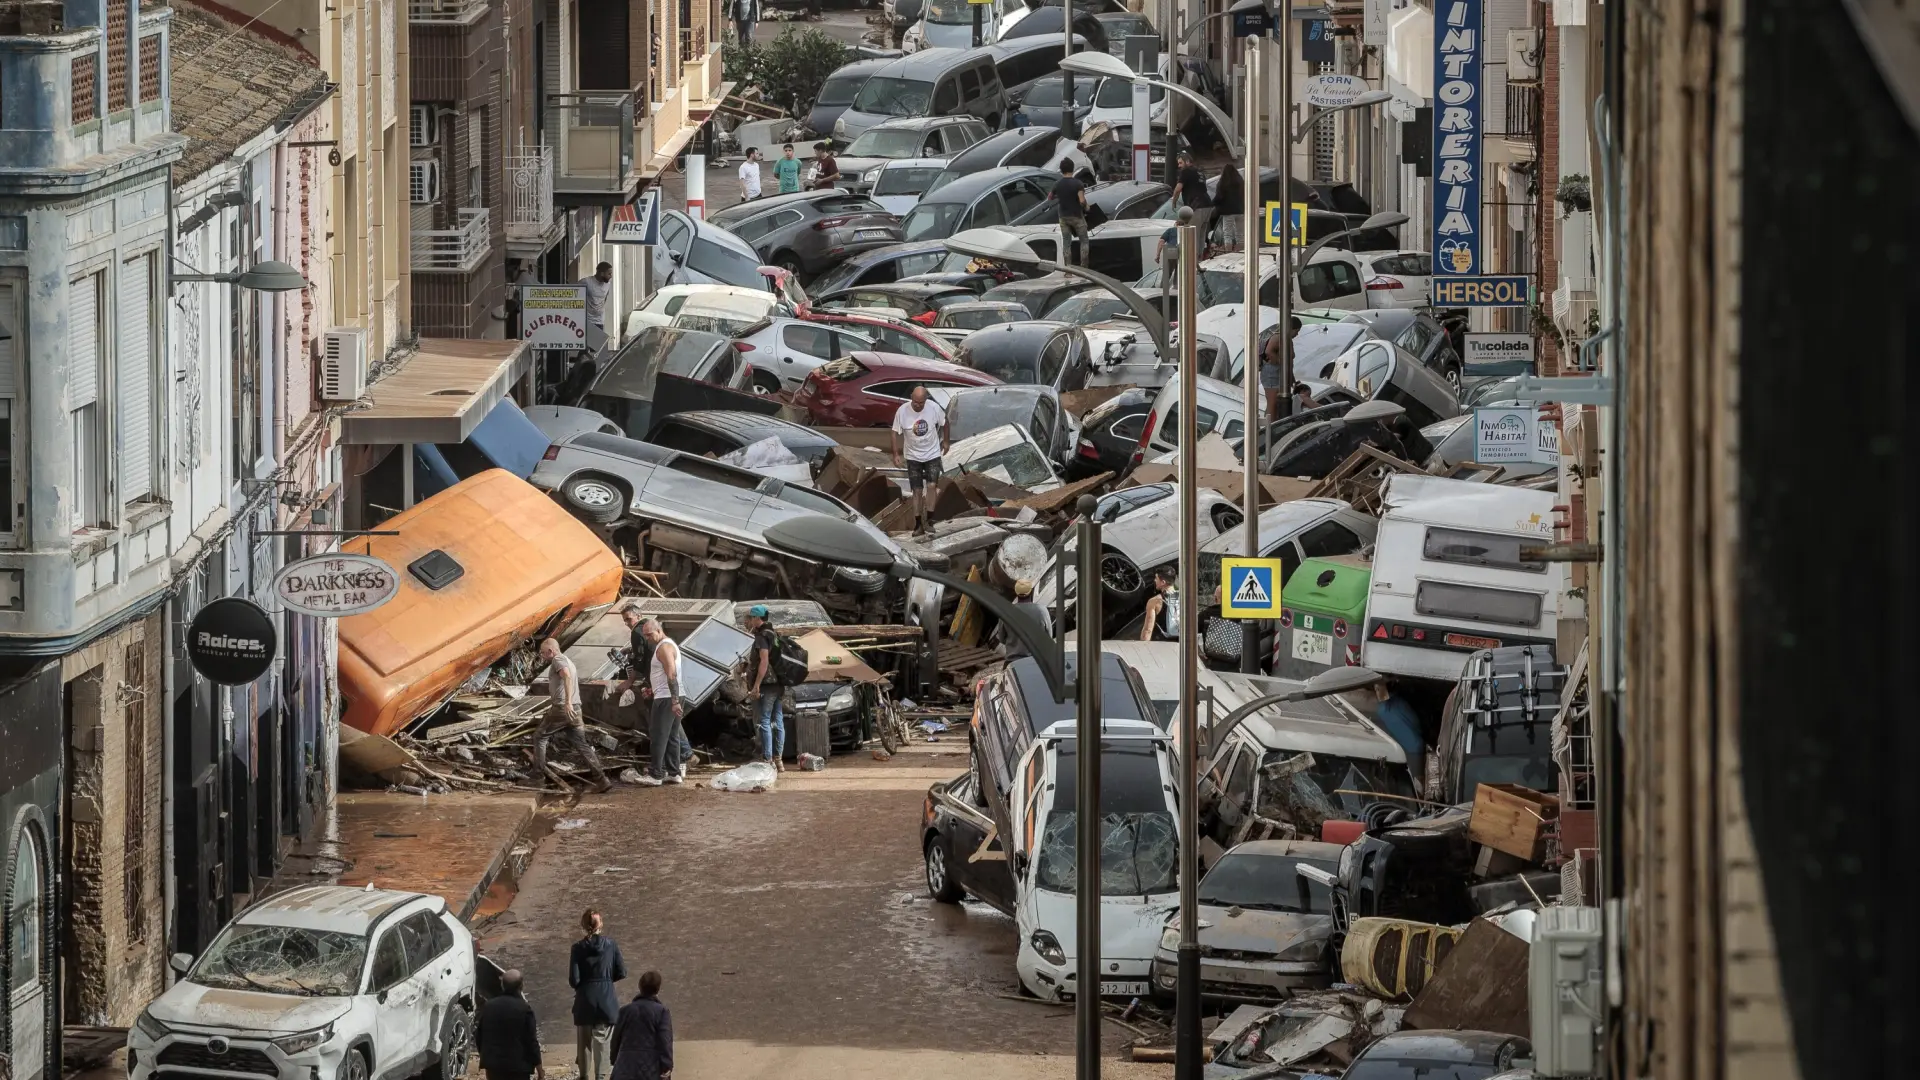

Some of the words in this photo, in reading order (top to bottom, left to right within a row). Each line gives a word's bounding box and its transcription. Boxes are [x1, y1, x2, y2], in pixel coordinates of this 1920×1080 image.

[1319, 76, 1352, 86] FORN
[1311, 95, 1357, 106] PASTISSER
[1438, 1, 1475, 236] INTORERIA
[613, 223, 642, 232] FIATC
[1436, 282, 1525, 302] HERSOL
[524, 314, 585, 338] GUERRERO
[1469, 341, 1529, 351] Tucolada
[1480, 420, 1507, 430] INMO
[1538, 430, 1557, 450] INM
[325, 560, 345, 572] PUB
[286, 571, 386, 593] DARKNESS
[303, 594, 340, 606] METAL
[343, 592, 368, 605] BAR
[198, 632, 261, 651] Raices
[197, 648, 229, 657] cocktail
